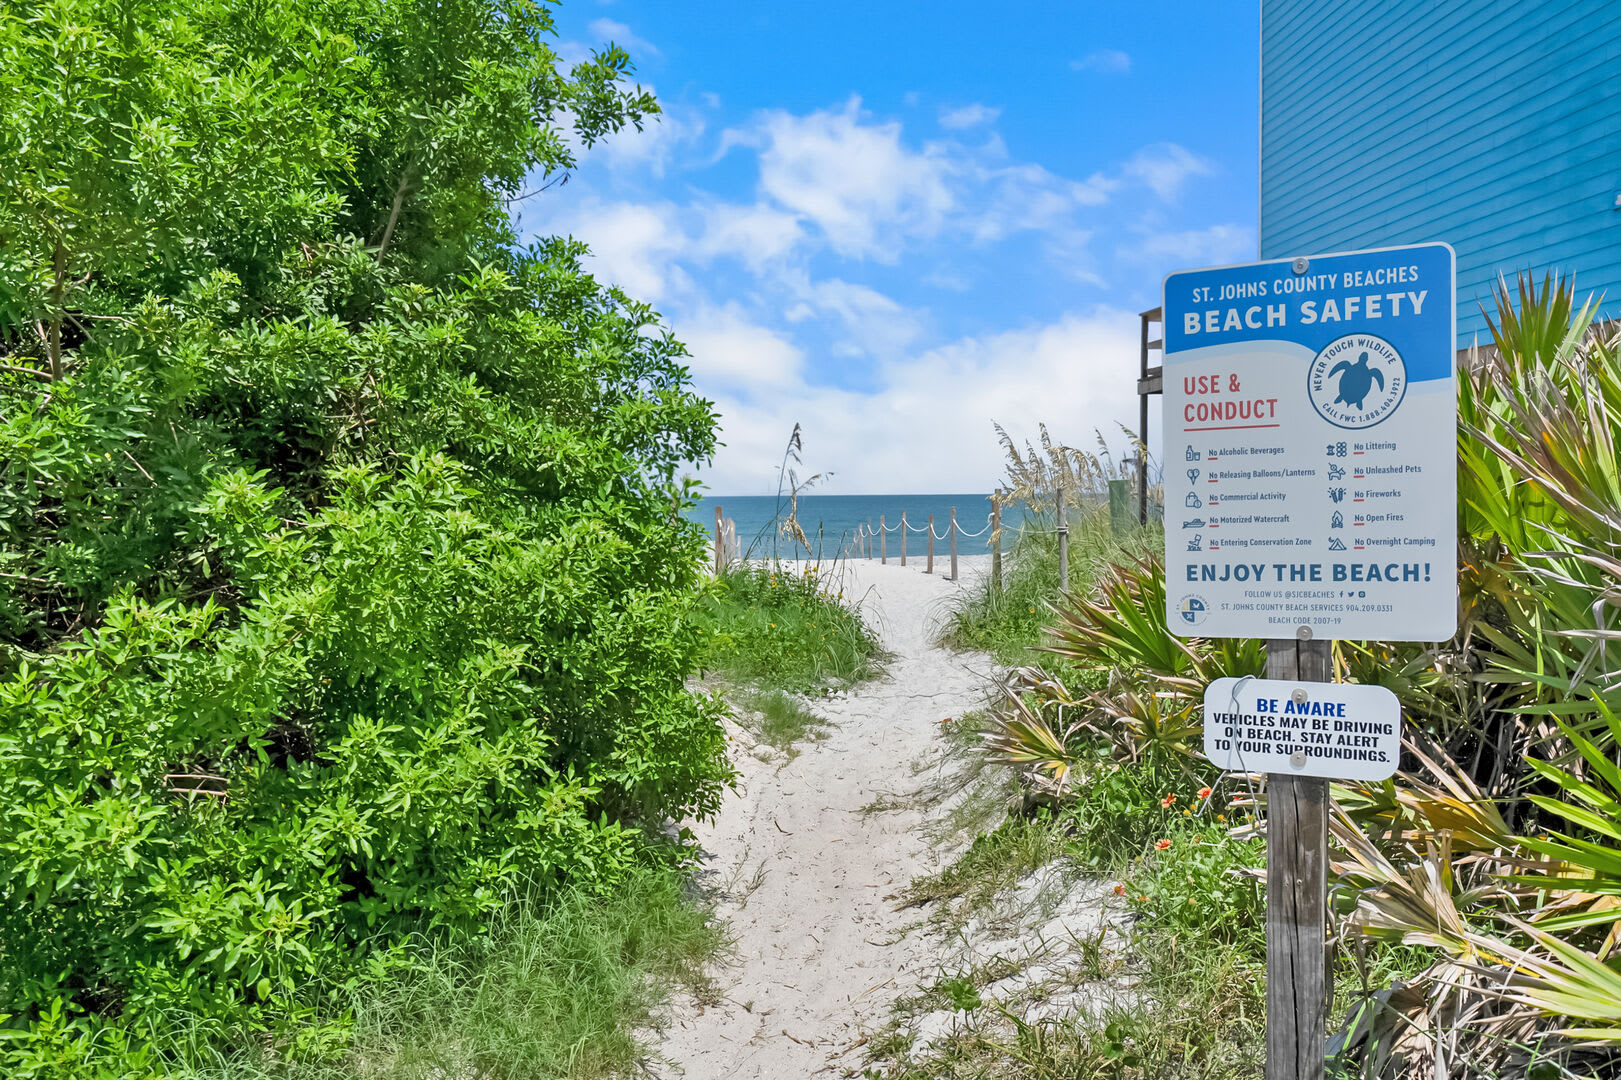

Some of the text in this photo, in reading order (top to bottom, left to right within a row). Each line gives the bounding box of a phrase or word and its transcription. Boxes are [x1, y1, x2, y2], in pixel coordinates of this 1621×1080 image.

[1193, 265, 1419, 303] ST. JOHNS COUNTY BEACHES
[1184, 290, 1428, 335] BEACH SAFETY
[1314, 338, 1397, 392] NEVER TOUCH WILDLIFE
[1184, 373, 1241, 395] USE &
[1184, 399, 1278, 422] CONDUCT
[1322, 402, 1337, 418] CALL
[1339, 413, 1356, 423] FWC
[1208, 446, 1285, 457] No Alcoholic Beverages
[1354, 441, 1397, 451] No Littering
[1209, 468, 1316, 479] No Releasing Balloons/Lanterns
[1354, 465, 1422, 475] No Unleashed Pets
[1220, 492, 1259, 501] Commercial
[1260, 491, 1287, 501] Activity
[1366, 489, 1402, 498] Fireworks
[1209, 514, 1290, 524] No Motorized Watercraft
[1355, 513, 1404, 523] No Open Fires
[1220, 538, 1248, 547] Entering
[1250, 538, 1293, 546] Conservation
[1295, 537, 1312, 546] Zone
[1355, 537, 1436, 547] No Overnight Camping
[1186, 563, 1432, 582] ENJOY THE BEACH!
[1244, 590, 1271, 598] FOLLOW
[1273, 590, 1283, 598] US
[1233, 603, 1254, 611] JOHNS
[1256, 603, 1283, 611] COUNTY
[1310, 604, 1344, 612] SERVICES
[1268, 616, 1291, 624] BEACH
[1293, 616, 1311, 624] CODE
[1257, 698, 1346, 717] BE AWARE
[1213, 713, 1393, 735] VEHICLES MAY BE DRIVING
[1225, 726, 1379, 748] ON BEACH. STAY ALERT
[1214, 739, 1230, 751] TO
[1236, 741, 1271, 753] YOUR
